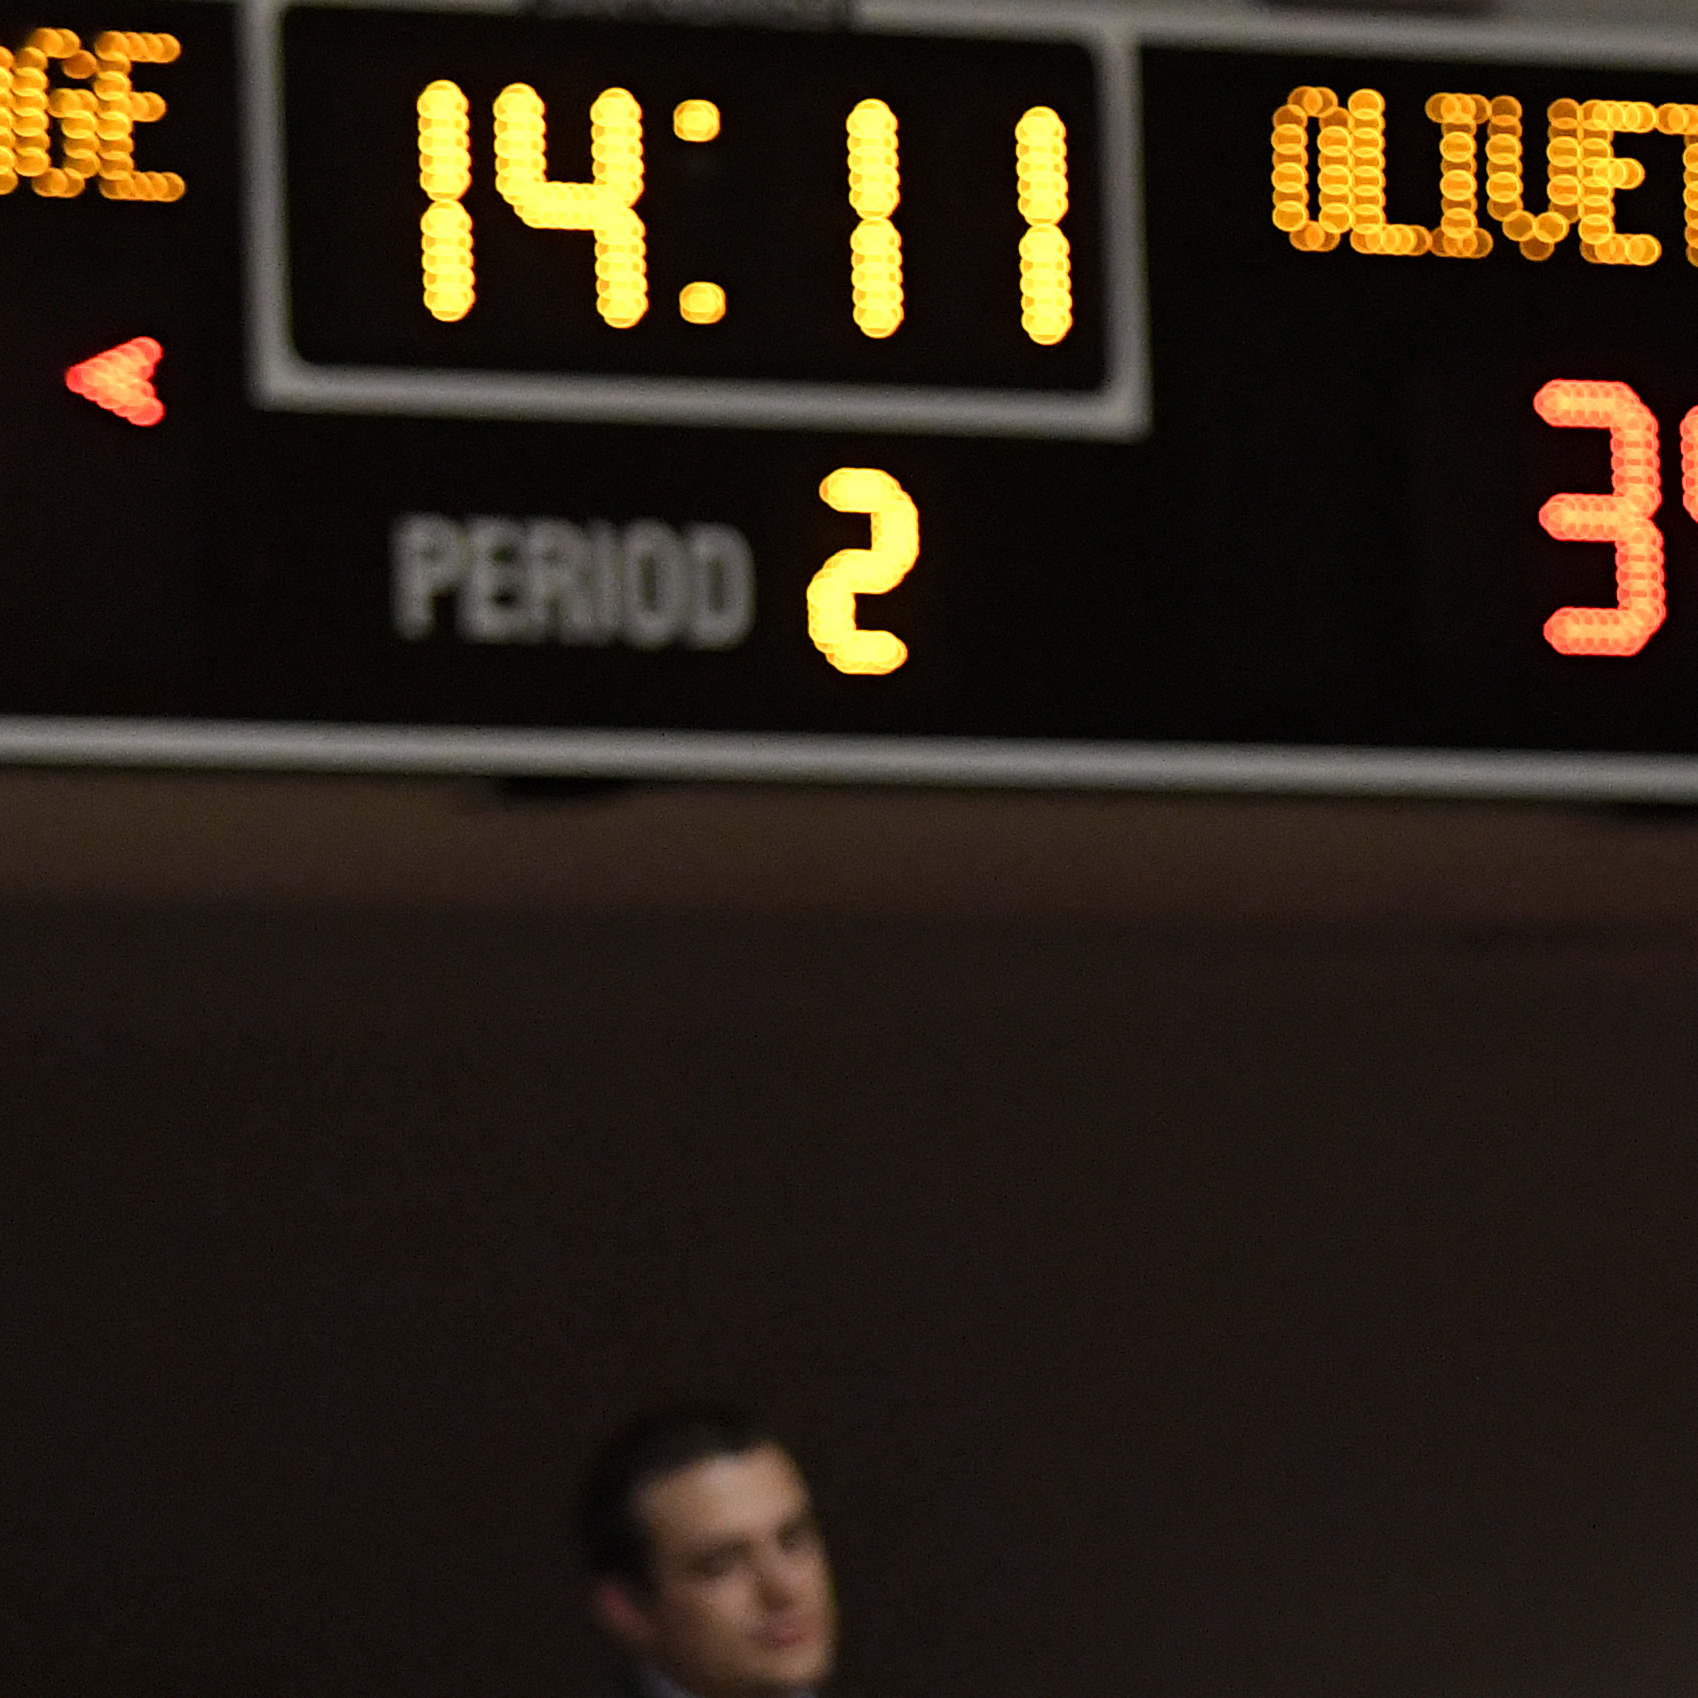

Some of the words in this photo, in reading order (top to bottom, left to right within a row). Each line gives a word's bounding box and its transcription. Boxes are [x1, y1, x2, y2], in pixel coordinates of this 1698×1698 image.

[0, 28, 186, 202] GE
[417, 80, 1073, 344] 14:11
[390, 512, 755, 650] PERIOD
[807, 467, 919, 675] 2
